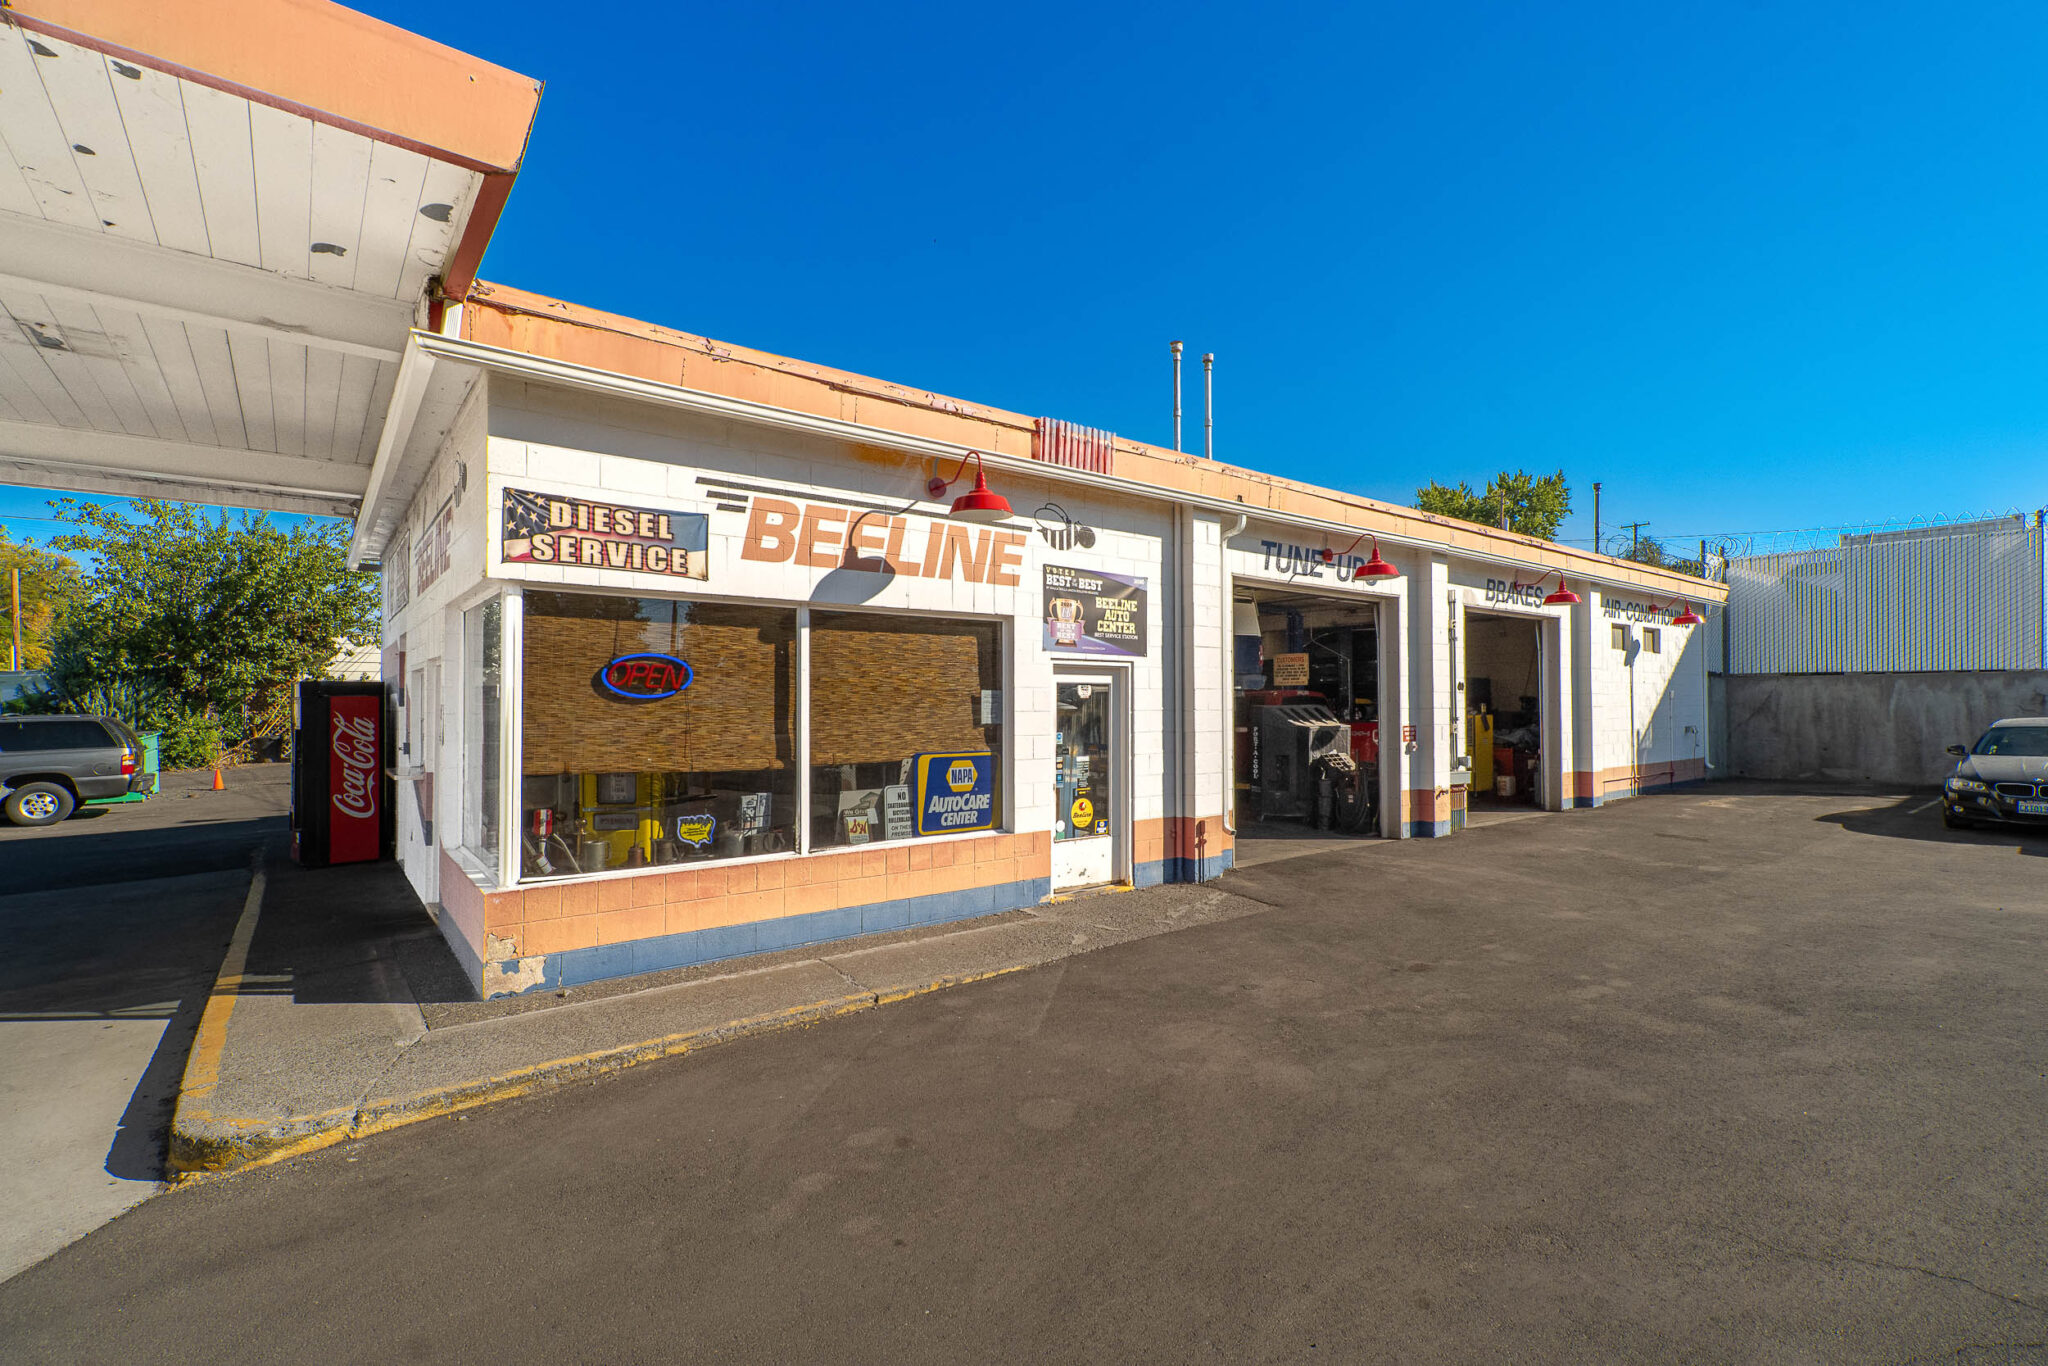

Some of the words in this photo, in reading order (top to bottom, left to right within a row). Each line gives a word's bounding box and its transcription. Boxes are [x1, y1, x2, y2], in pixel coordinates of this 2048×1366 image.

[549, 500, 675, 541] DIESEL
[740, 496, 1028, 587] BEELINE
[530, 533, 689, 575] SERVICE
[1046, 567, 1075, 576] VOTED
[1046, 574, 1072, 587] BEST
[1079, 578, 1103, 591] BEST
[1486, 578, 1544, 609] BRAKES
[1095, 596, 1138, 612] BEELINE
[1104, 609, 1130, 622] AUTO
[1097, 620, 1135, 633] CENTER
[607, 661, 687, 690] OPEN
[332, 711, 376, 819] Coca-Cola
[951, 768, 973, 784] NAPA
[897, 791, 906, 801] NO
[940, 811, 978, 827] CENTER
